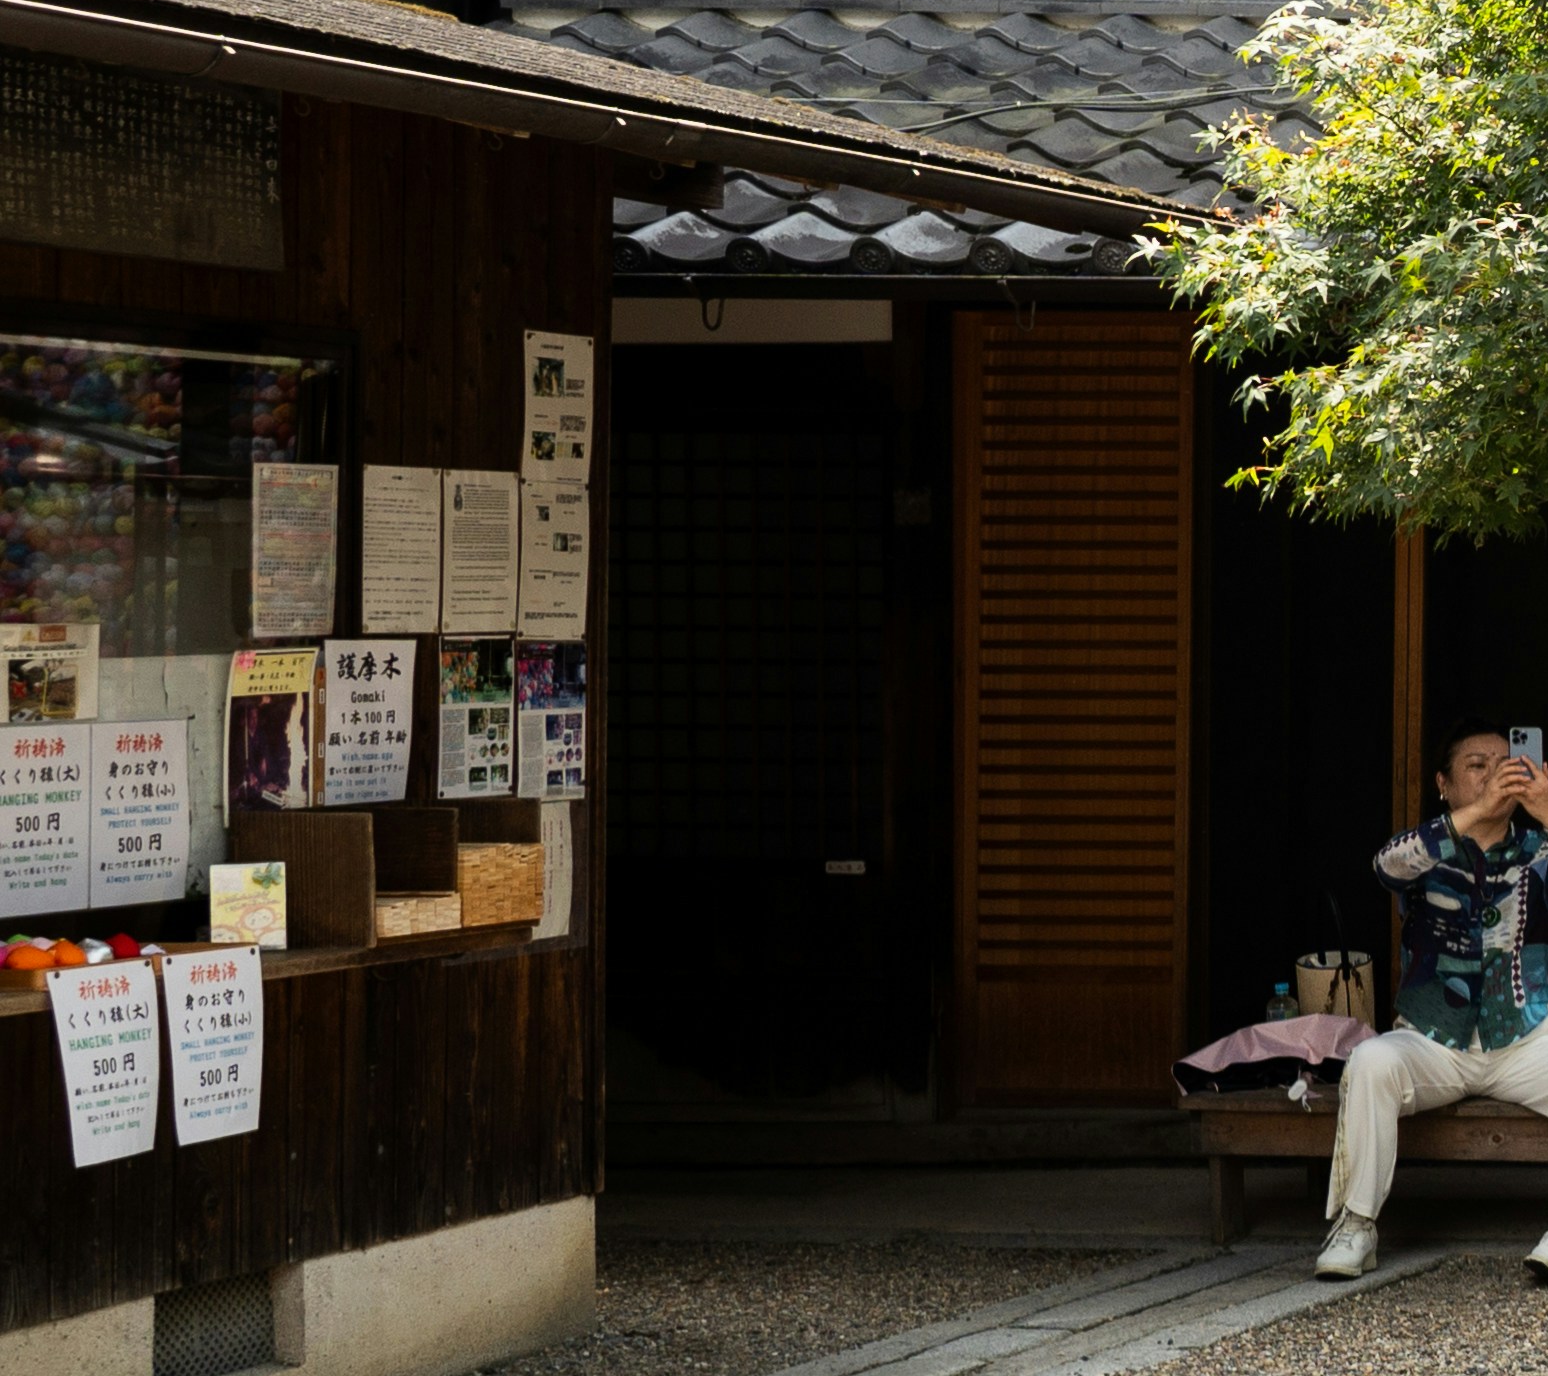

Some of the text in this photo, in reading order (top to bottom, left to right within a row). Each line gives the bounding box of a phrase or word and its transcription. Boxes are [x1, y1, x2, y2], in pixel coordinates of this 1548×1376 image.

[336, 651, 402, 683] 護摩木
[351, 689, 386, 704] Gomaki
[0, 792, 39, 807] ANGING
[185, 988, 247, 1011] 身のお守り
[68, 1027, 152, 1052] HANGING MONKEY
[93, 1057, 117, 1077] 500
[200, 1068, 222, 1088] 500
